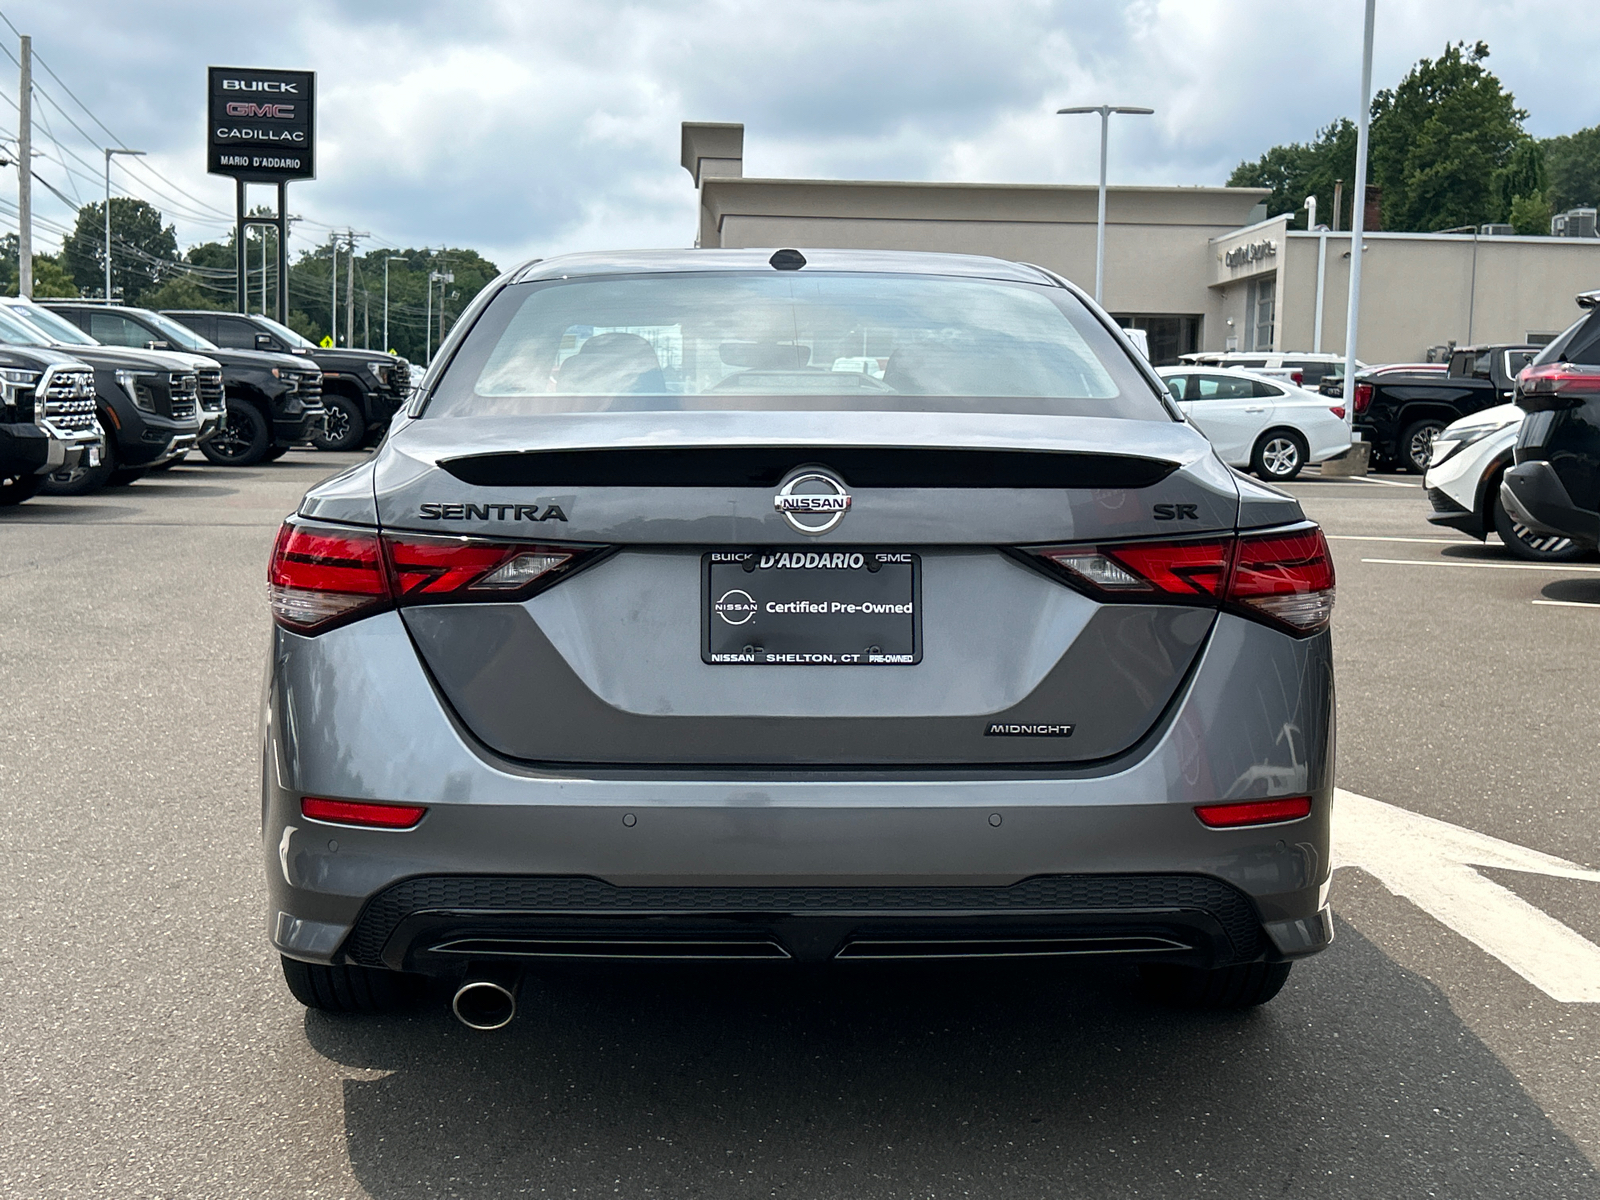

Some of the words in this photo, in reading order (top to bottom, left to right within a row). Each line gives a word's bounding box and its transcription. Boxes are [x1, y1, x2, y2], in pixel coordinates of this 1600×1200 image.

[222, 79, 299, 93] BUICK
[226, 102, 295, 119] GMC
[216, 128, 304, 141] CADILLAC
[220, 155, 249, 166] MARIO
[252, 157, 301, 169] D'ADDARIO
[783, 498, 844, 508] NISSAN
[418, 502, 569, 522] SENTRA
[1153, 503, 1199, 520] SR
[711, 553, 753, 561] BUICK
[759, 552, 865, 569] D'ADDARIO
[875, 553, 912, 562] GMC
[715, 603, 758, 611] NISSAN
[765, 601, 828, 613] Certified
[831, 602, 913, 614] Pre-Owned
[711, 654, 755, 662] NISSAN
[766, 654, 837, 663] SHELTON,
[841, 654, 860, 662] CT
[869, 655, 913, 663] PRE-OWNED
[990, 724, 1071, 733] MIDNIGHT
